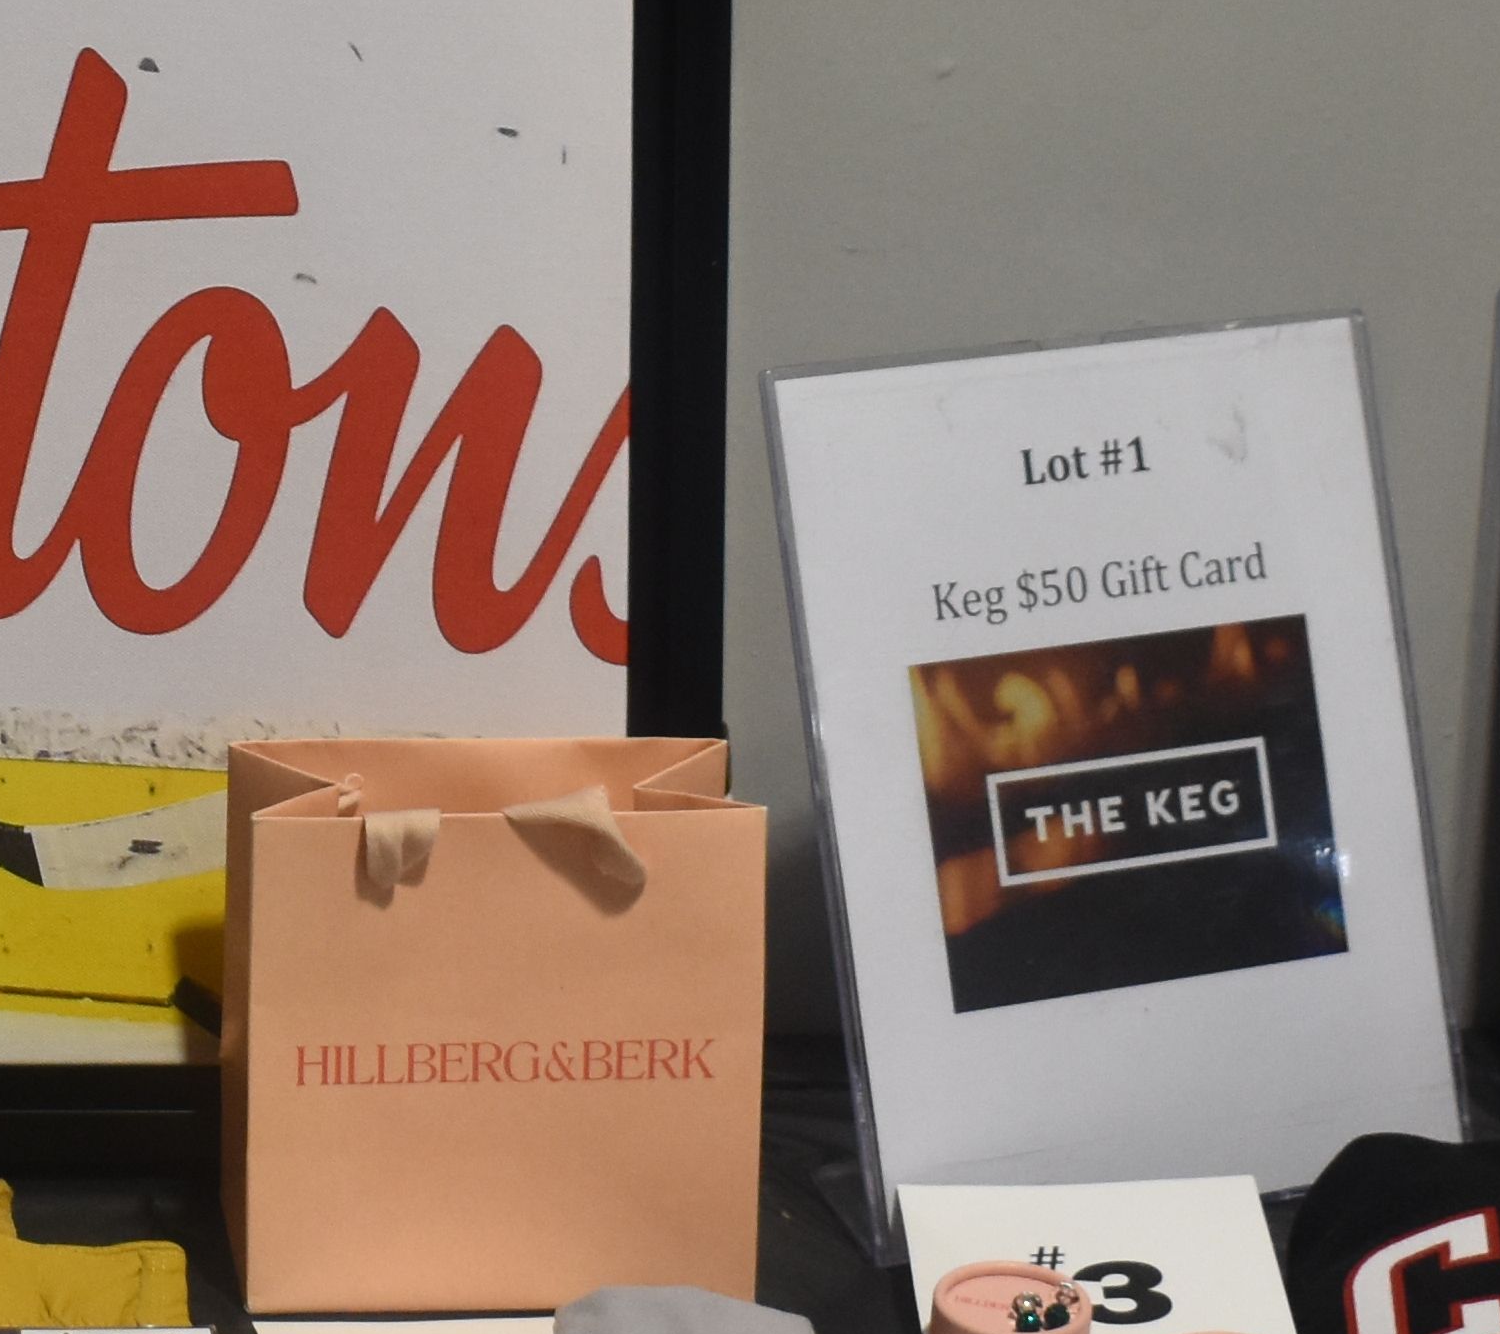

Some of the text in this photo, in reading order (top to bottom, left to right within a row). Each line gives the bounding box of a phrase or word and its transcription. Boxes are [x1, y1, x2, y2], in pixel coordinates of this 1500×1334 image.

[1021, 436, 1152, 485] Lot #1
[933, 543, 1268, 626] Keg $50 Gift Card
[1025, 781, 1241, 844] THE KEG
[295, 1038, 717, 1088] HILLBERG&BERK
[1030, 1246, 1173, 1325] #3
